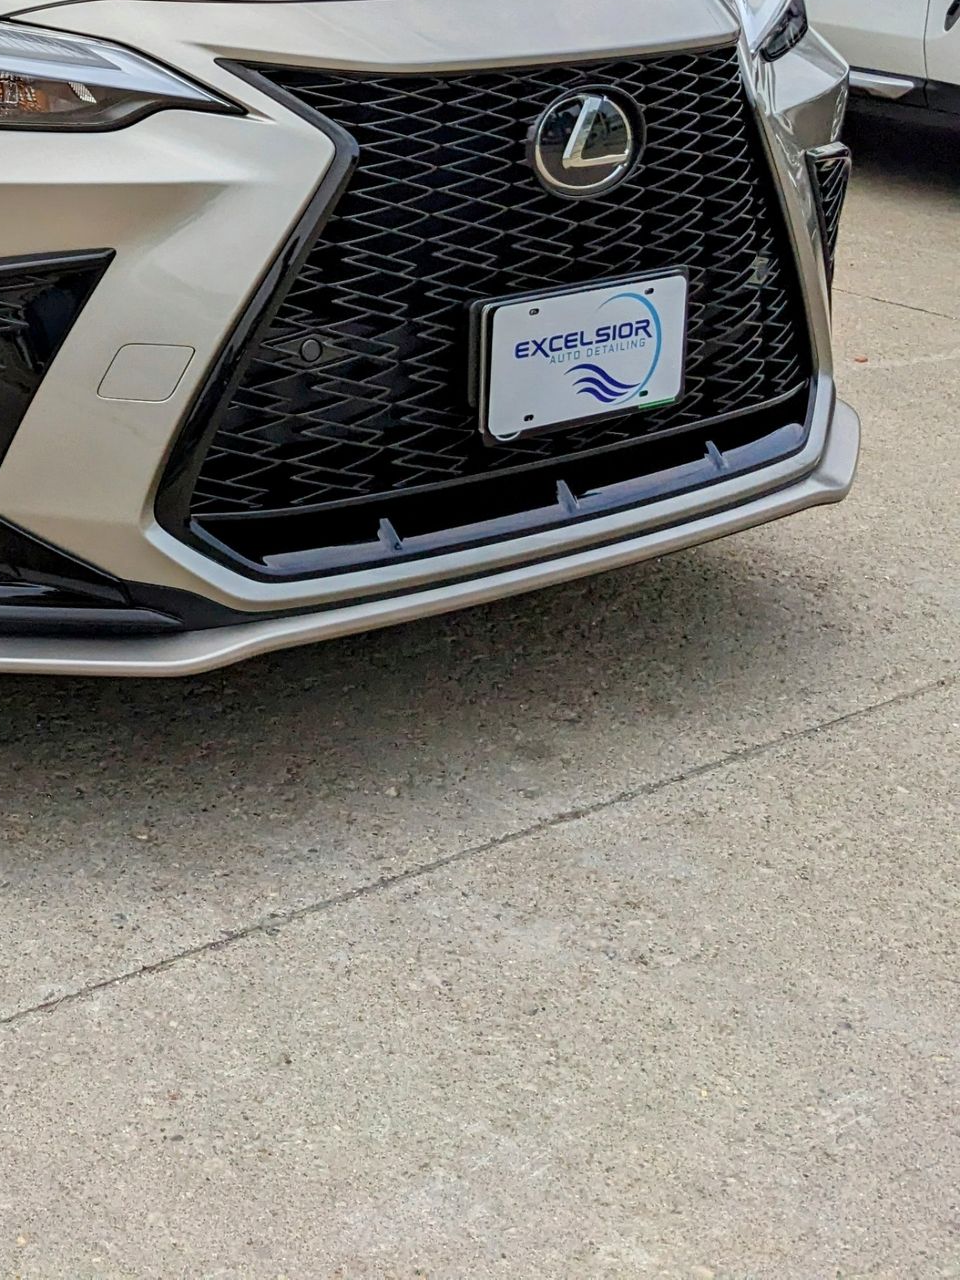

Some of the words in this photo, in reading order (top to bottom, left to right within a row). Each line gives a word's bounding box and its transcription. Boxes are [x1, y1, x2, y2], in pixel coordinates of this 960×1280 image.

[514, 318, 653, 360] EXCELSIOR
[549, 349, 581, 365] AUTO
[586, 337, 647, 359] DETAILING
